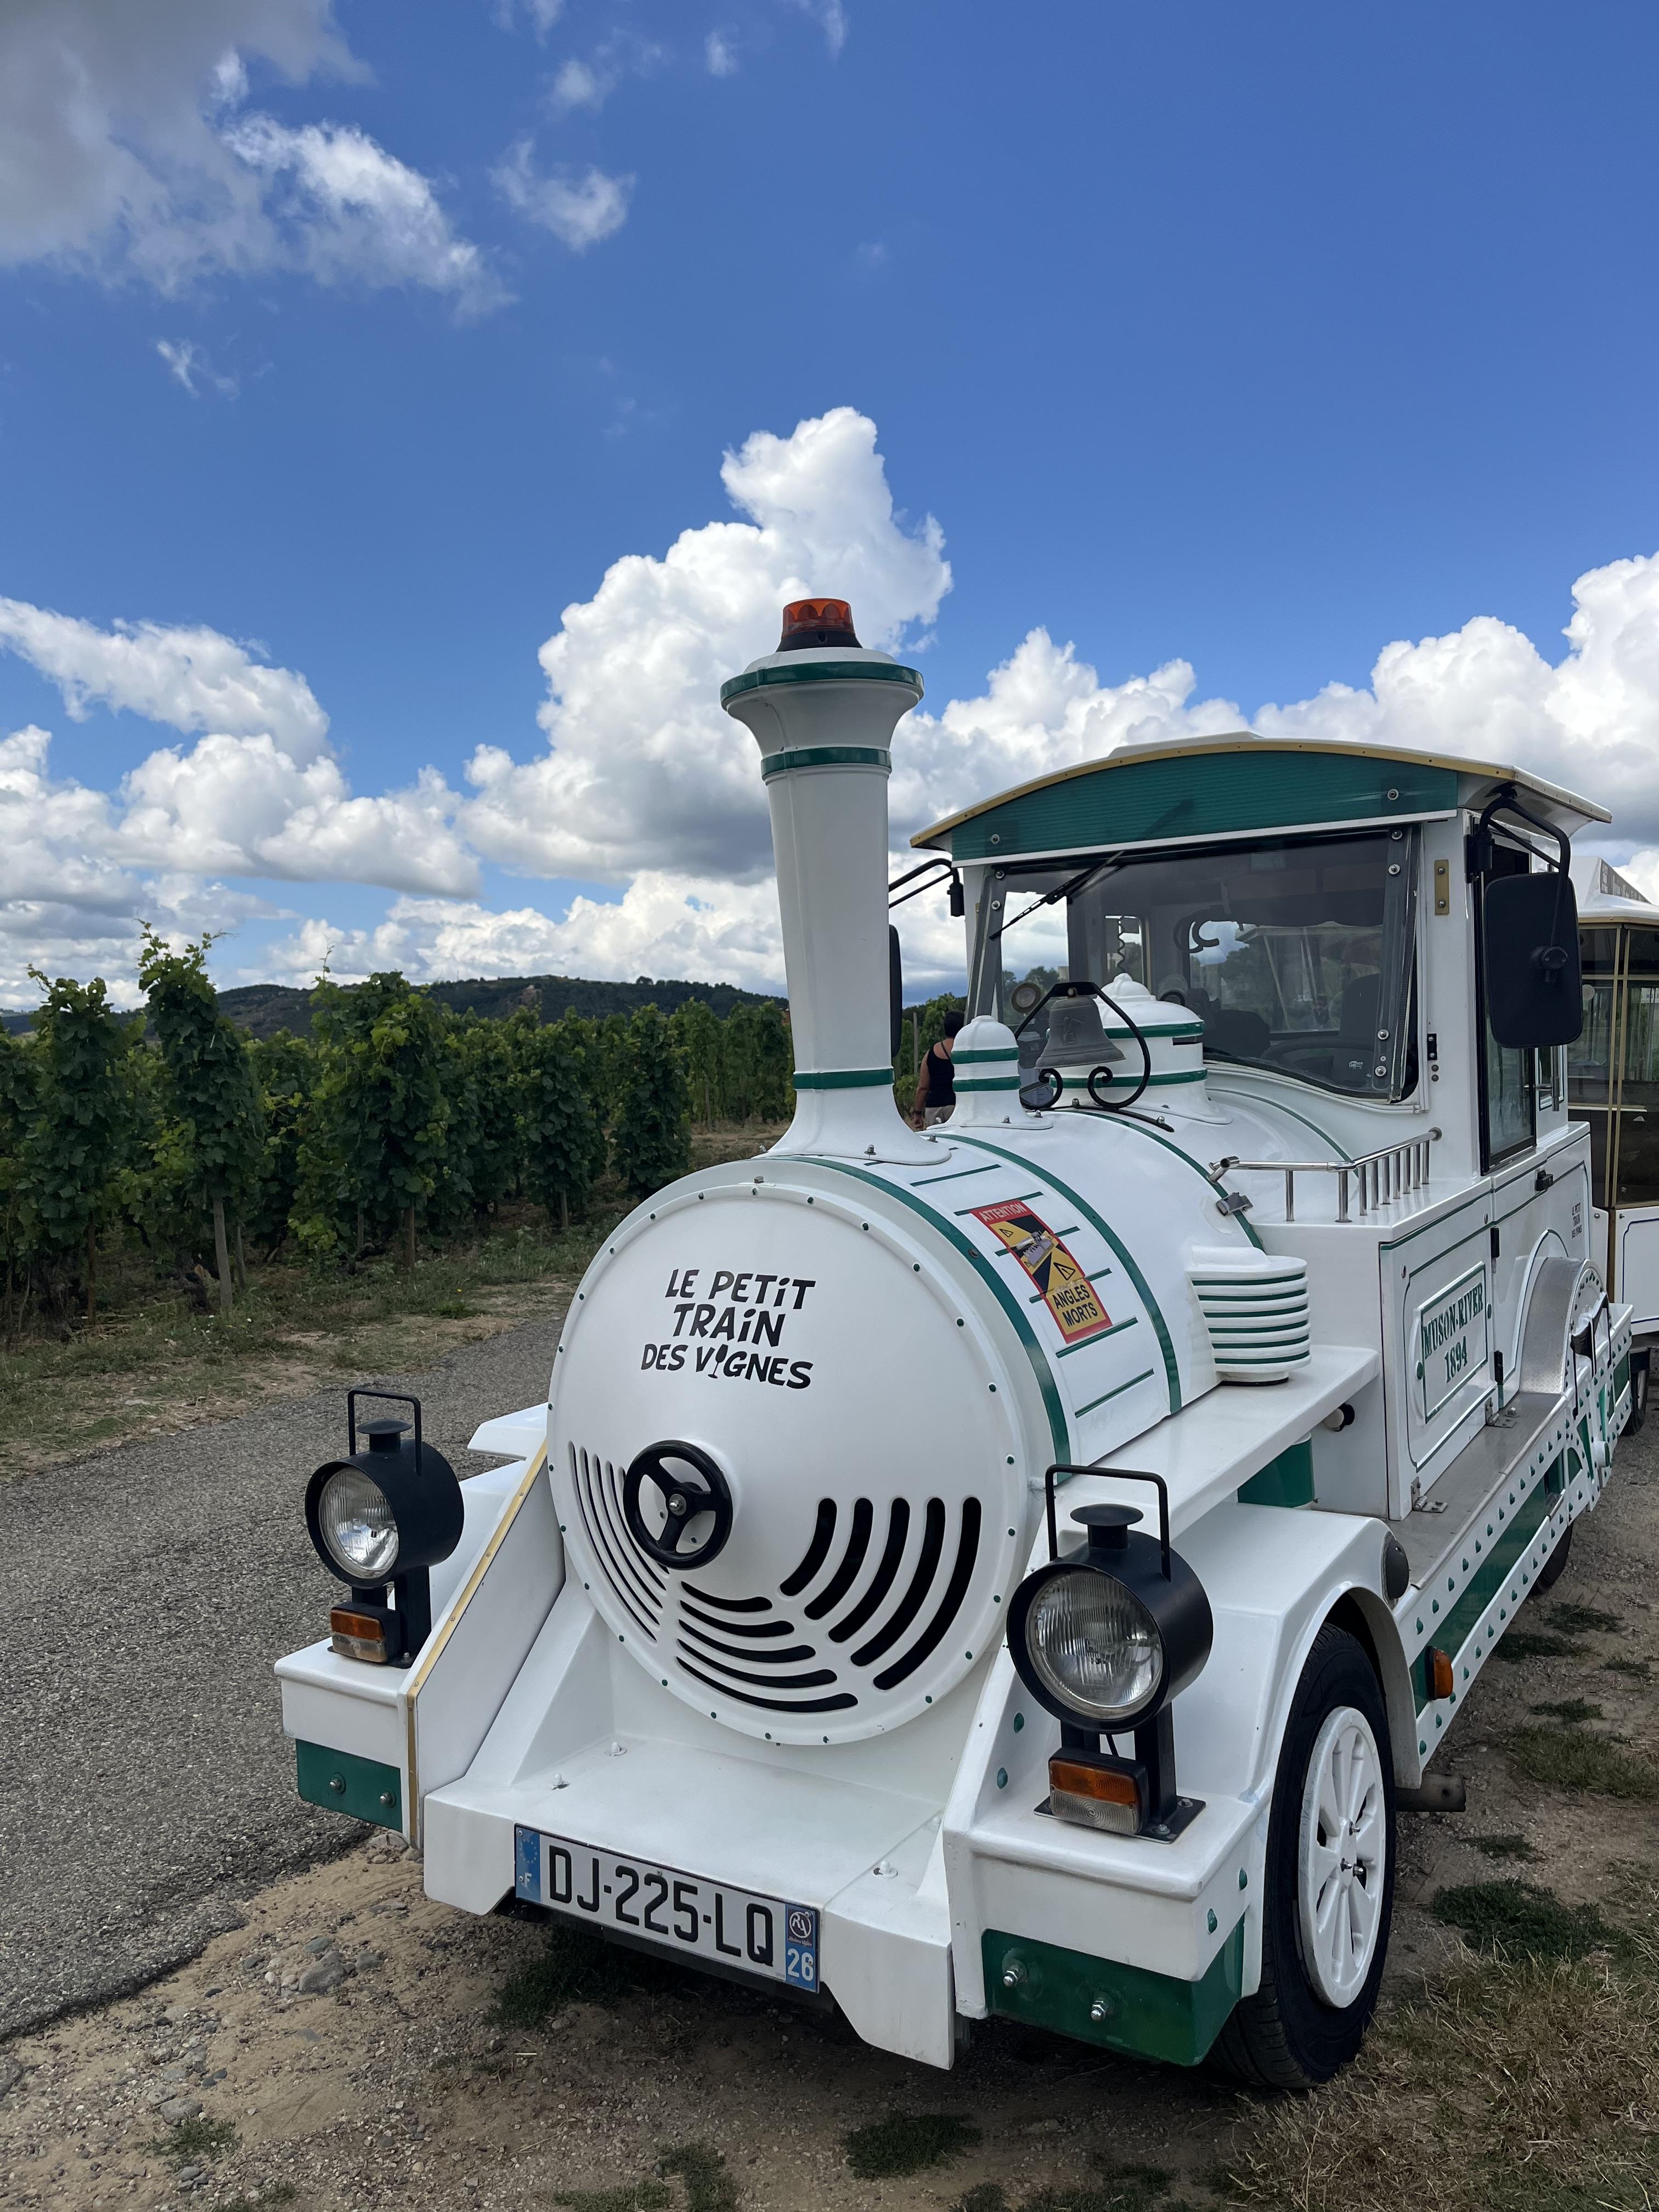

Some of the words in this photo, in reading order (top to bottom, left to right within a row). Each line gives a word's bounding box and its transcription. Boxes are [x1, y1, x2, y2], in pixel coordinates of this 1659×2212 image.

[979, 1203, 1027, 1222] ATTENTION
[665, 1269, 700, 1298] LE
[1052, 1284, 1090, 1310] ANGLES
[1062, 1302, 1098, 1327] MORTS
[641, 1344, 689, 1371] DES
[1445, 1335, 1468, 1383] 1894
[524, 1872, 532, 1887] F
[549, 1845, 774, 1967] DJ-225-LQ
[787, 1948, 814, 1981] 26
